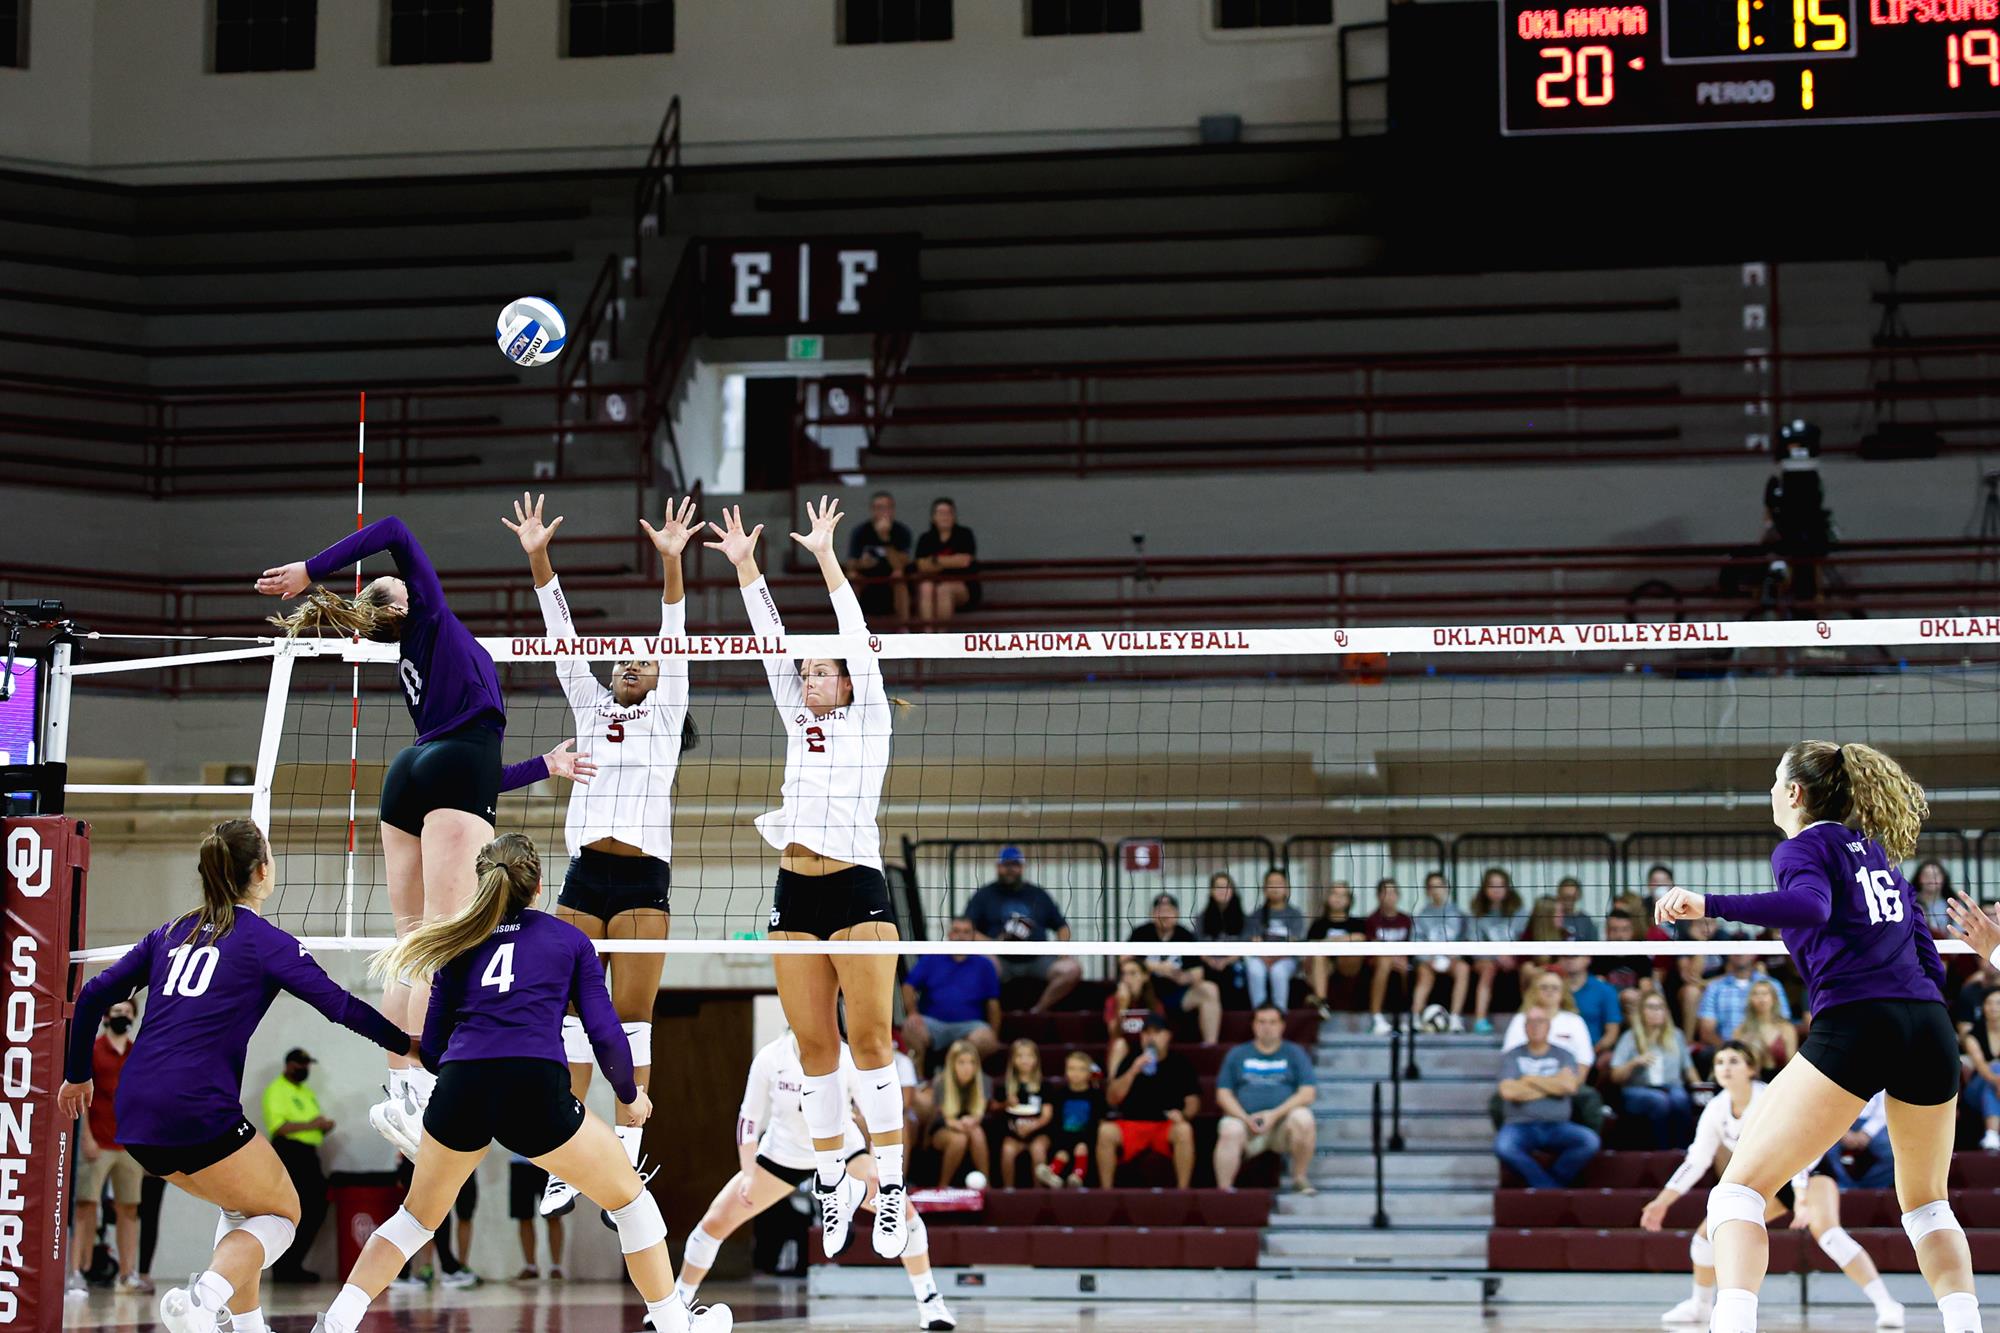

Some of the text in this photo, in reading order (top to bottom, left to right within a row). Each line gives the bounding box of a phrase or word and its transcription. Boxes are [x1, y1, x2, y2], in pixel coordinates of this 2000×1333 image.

[1518, 6, 1648, 39] OKLAHOMA
[1737, 0, 1847, 51] 1:15
[1536, 45, 1614, 108] 20
[1947, 28, 2000, 89] 19
[1697, 80, 1774, 105] PERIOD
[731, 250, 878, 315] E F
[511, 636, 787, 656] OKLAHOMA VOLLEYBALL
[964, 631, 1250, 652] OKLAHOMA VOLLEYBALL
[1433, 623, 1729, 646] OKLAHOMA VOLLEYBALL
[805, 725, 827, 753] 2
[1855, 865, 1904, 926] 16
[162, 943, 220, 997] 10
[481, 942, 515, 994] 4
